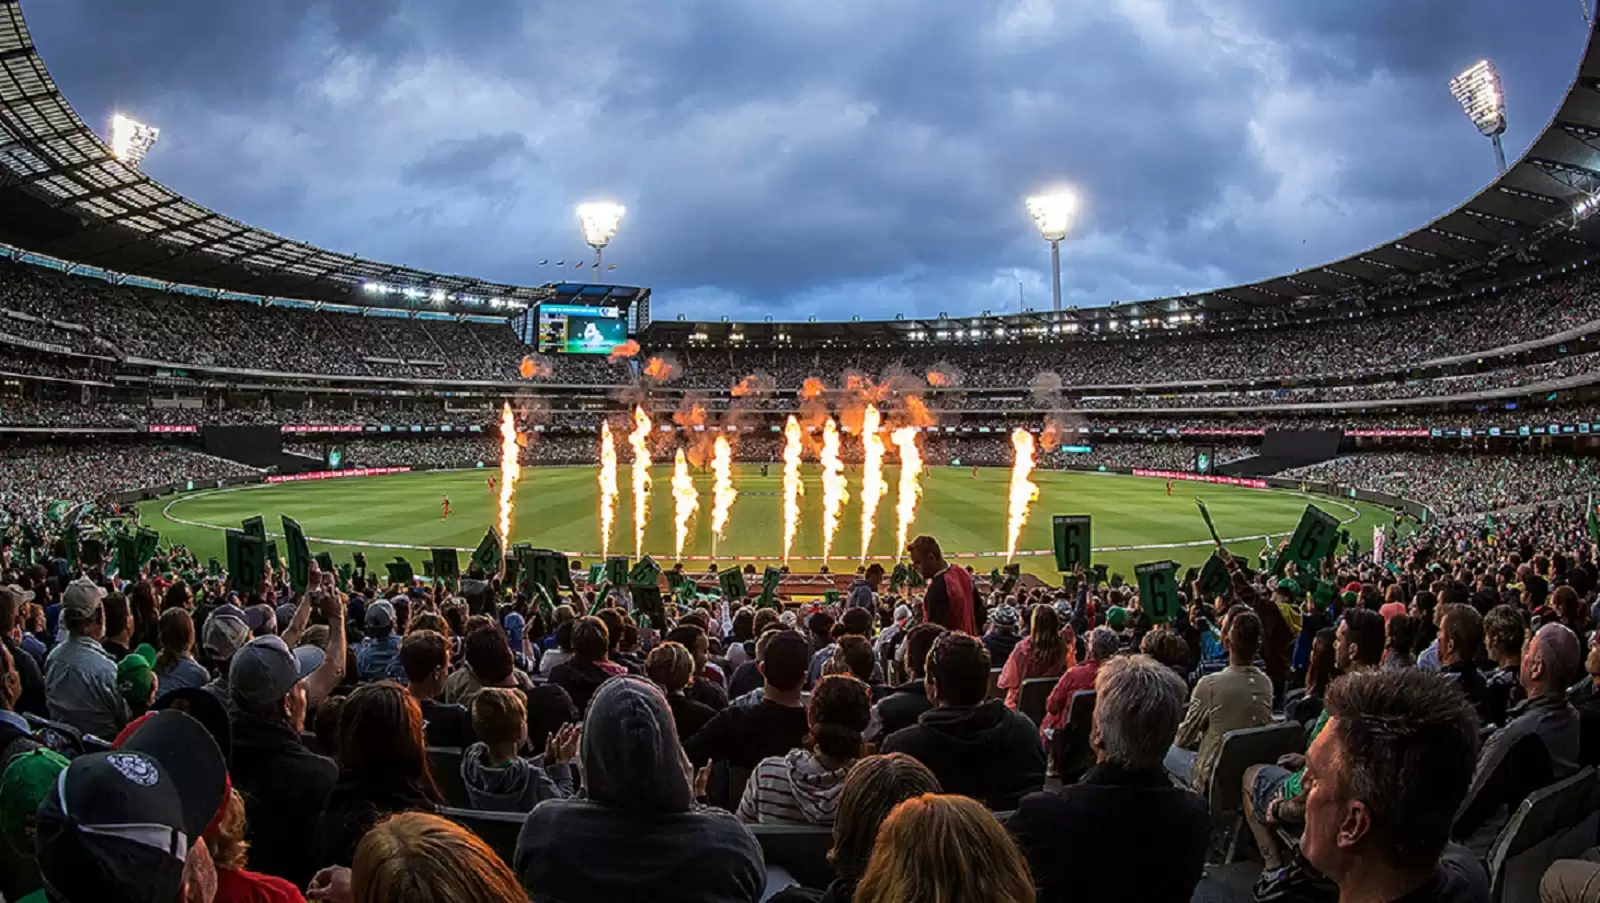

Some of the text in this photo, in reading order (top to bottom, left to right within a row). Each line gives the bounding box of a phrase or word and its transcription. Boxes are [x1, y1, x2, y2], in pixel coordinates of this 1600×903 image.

[1065, 525, 1081, 567] 6
[1299, 520, 1328, 560] 6
[239, 541, 254, 586] 6
[535, 557, 546, 584] 6
[614, 560, 622, 584] 6
[728, 574, 739, 597] 6
[1149, 572, 1168, 616] 6
